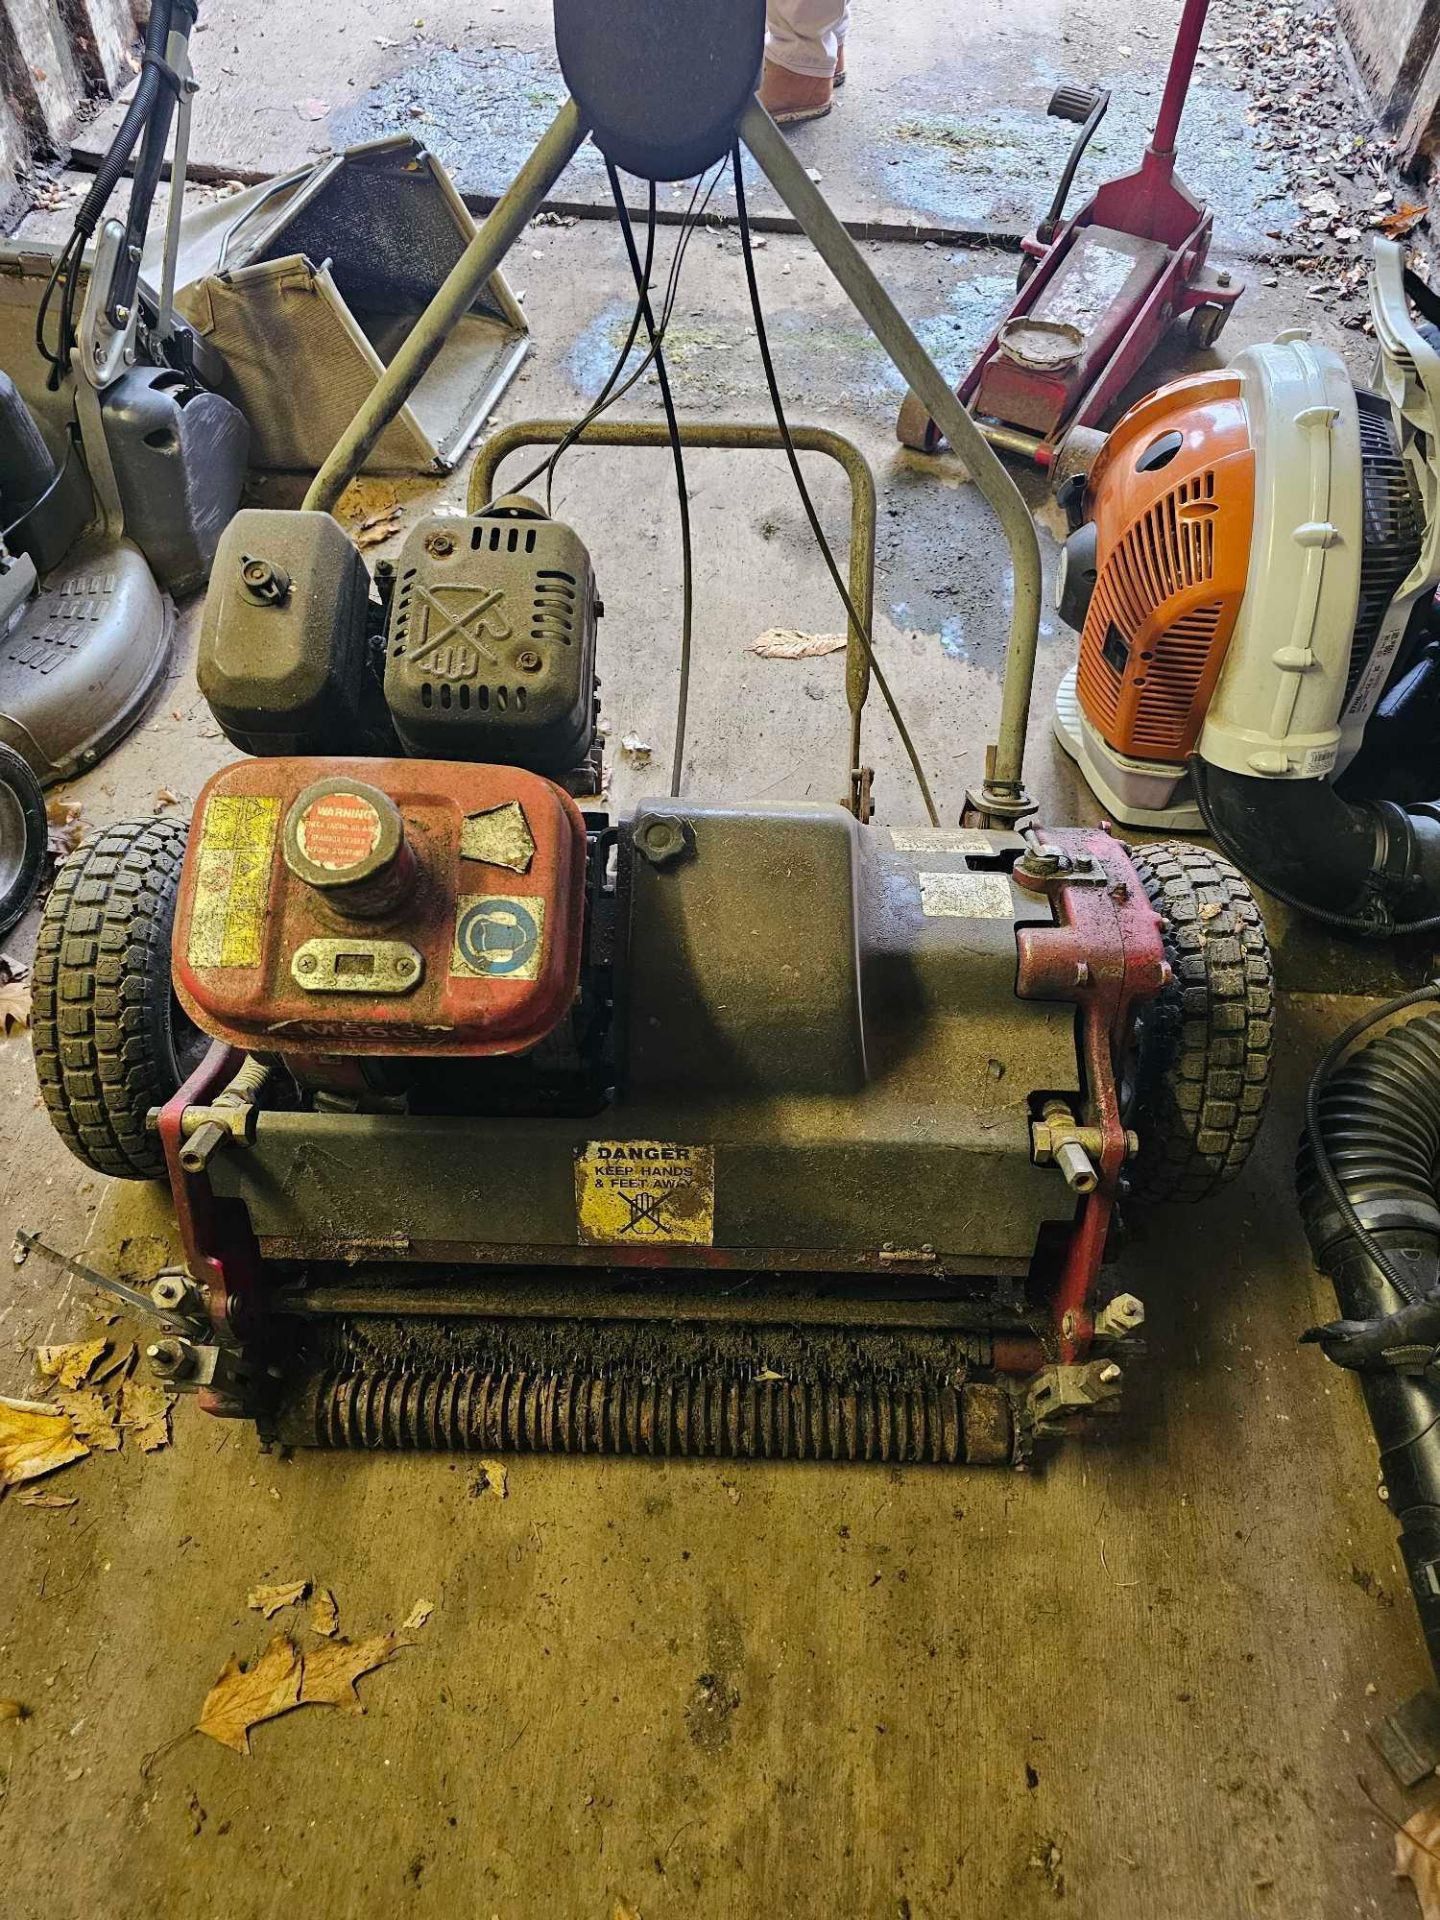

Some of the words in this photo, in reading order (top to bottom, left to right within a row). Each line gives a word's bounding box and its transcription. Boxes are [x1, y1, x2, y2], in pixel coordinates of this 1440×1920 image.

[317, 806, 372, 819] WARNING
[597, 1147, 690, 1160] DANGER
[595, 1166, 634, 1176] KEEP
[641, 1166, 693, 1177] HANDS
[594, 1179, 604, 1188] &
[611, 1179, 648, 1188] FEET
[653, 1179, 692, 1189] AWAY
